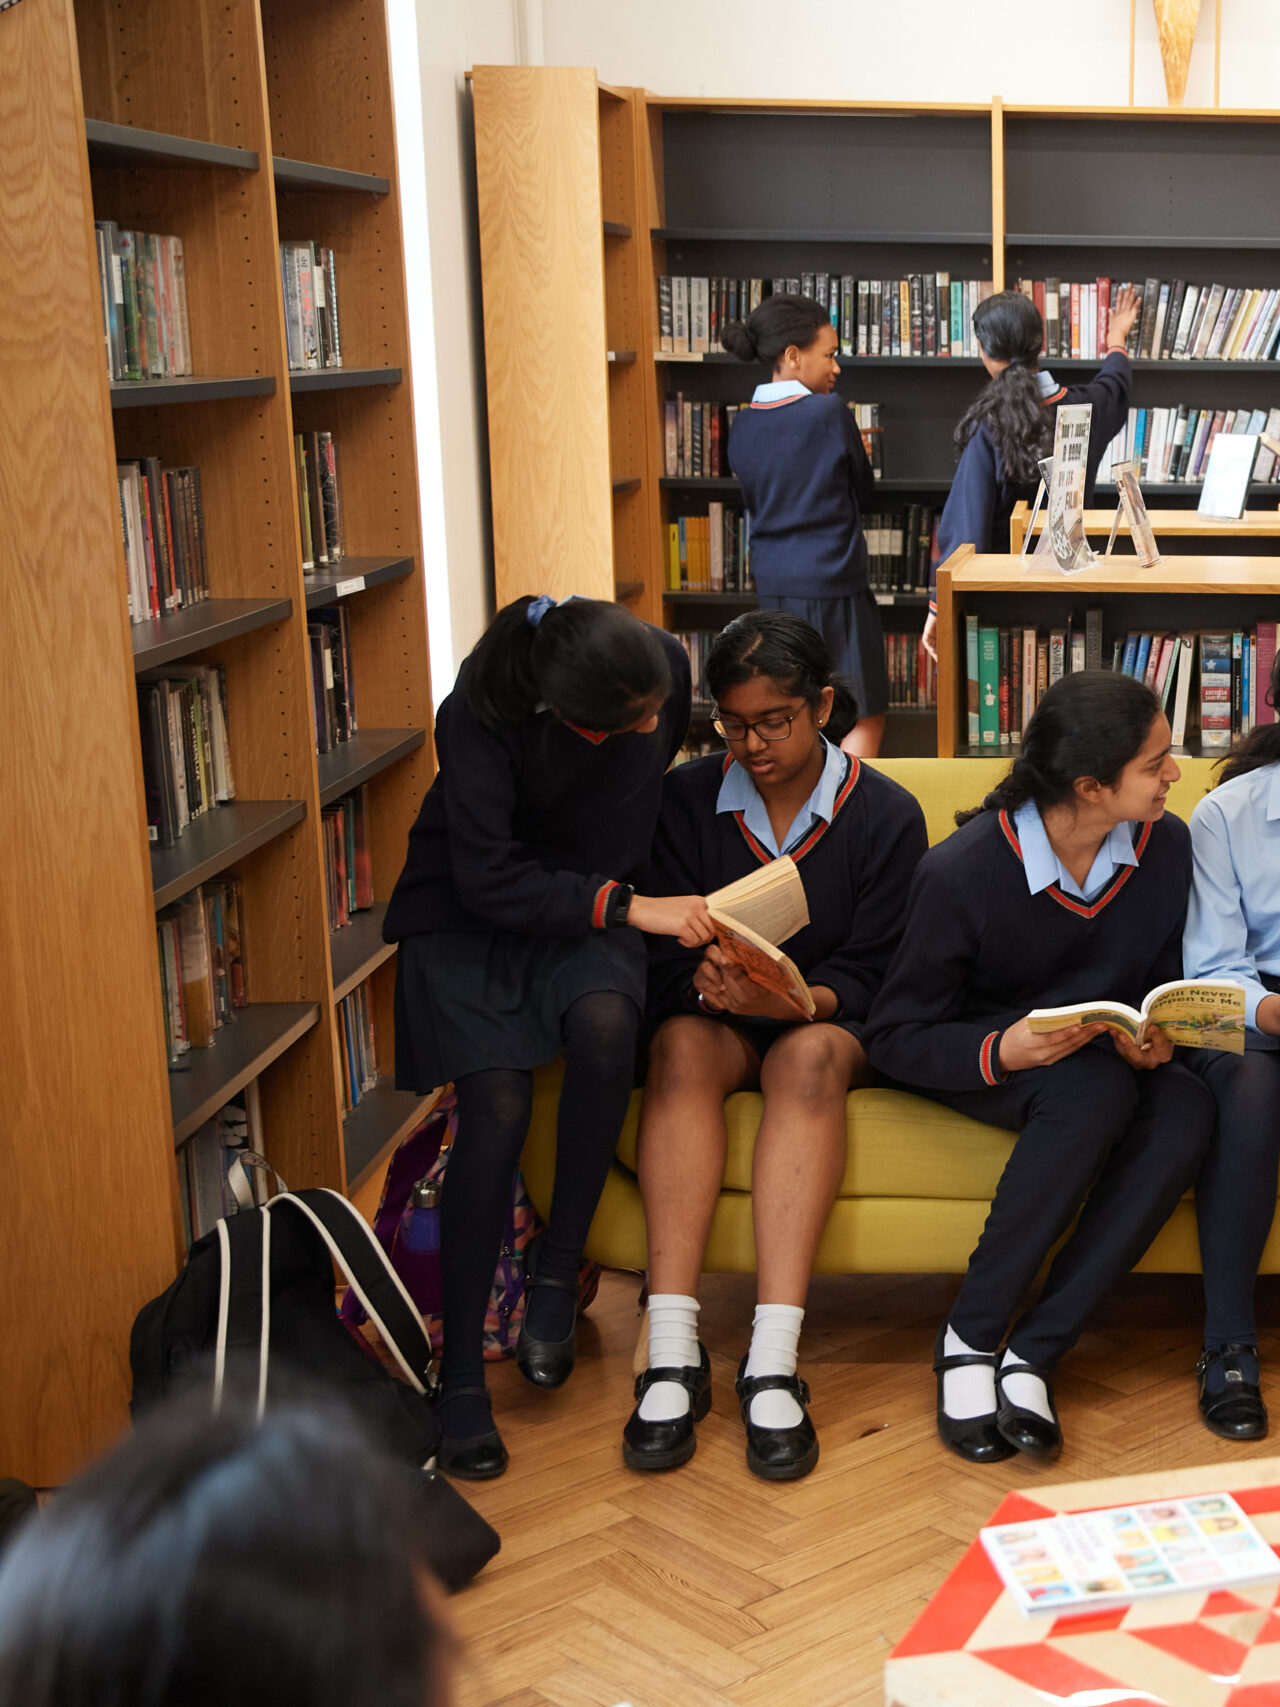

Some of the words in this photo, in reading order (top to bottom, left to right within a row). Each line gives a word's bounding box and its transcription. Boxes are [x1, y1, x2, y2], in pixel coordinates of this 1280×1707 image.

[1158, 990, 1184, 1002] Will
[1190, 990, 1234, 998] Never
[1201, 996, 1215, 1004] to
[1220, 998, 1240, 1006] Me
